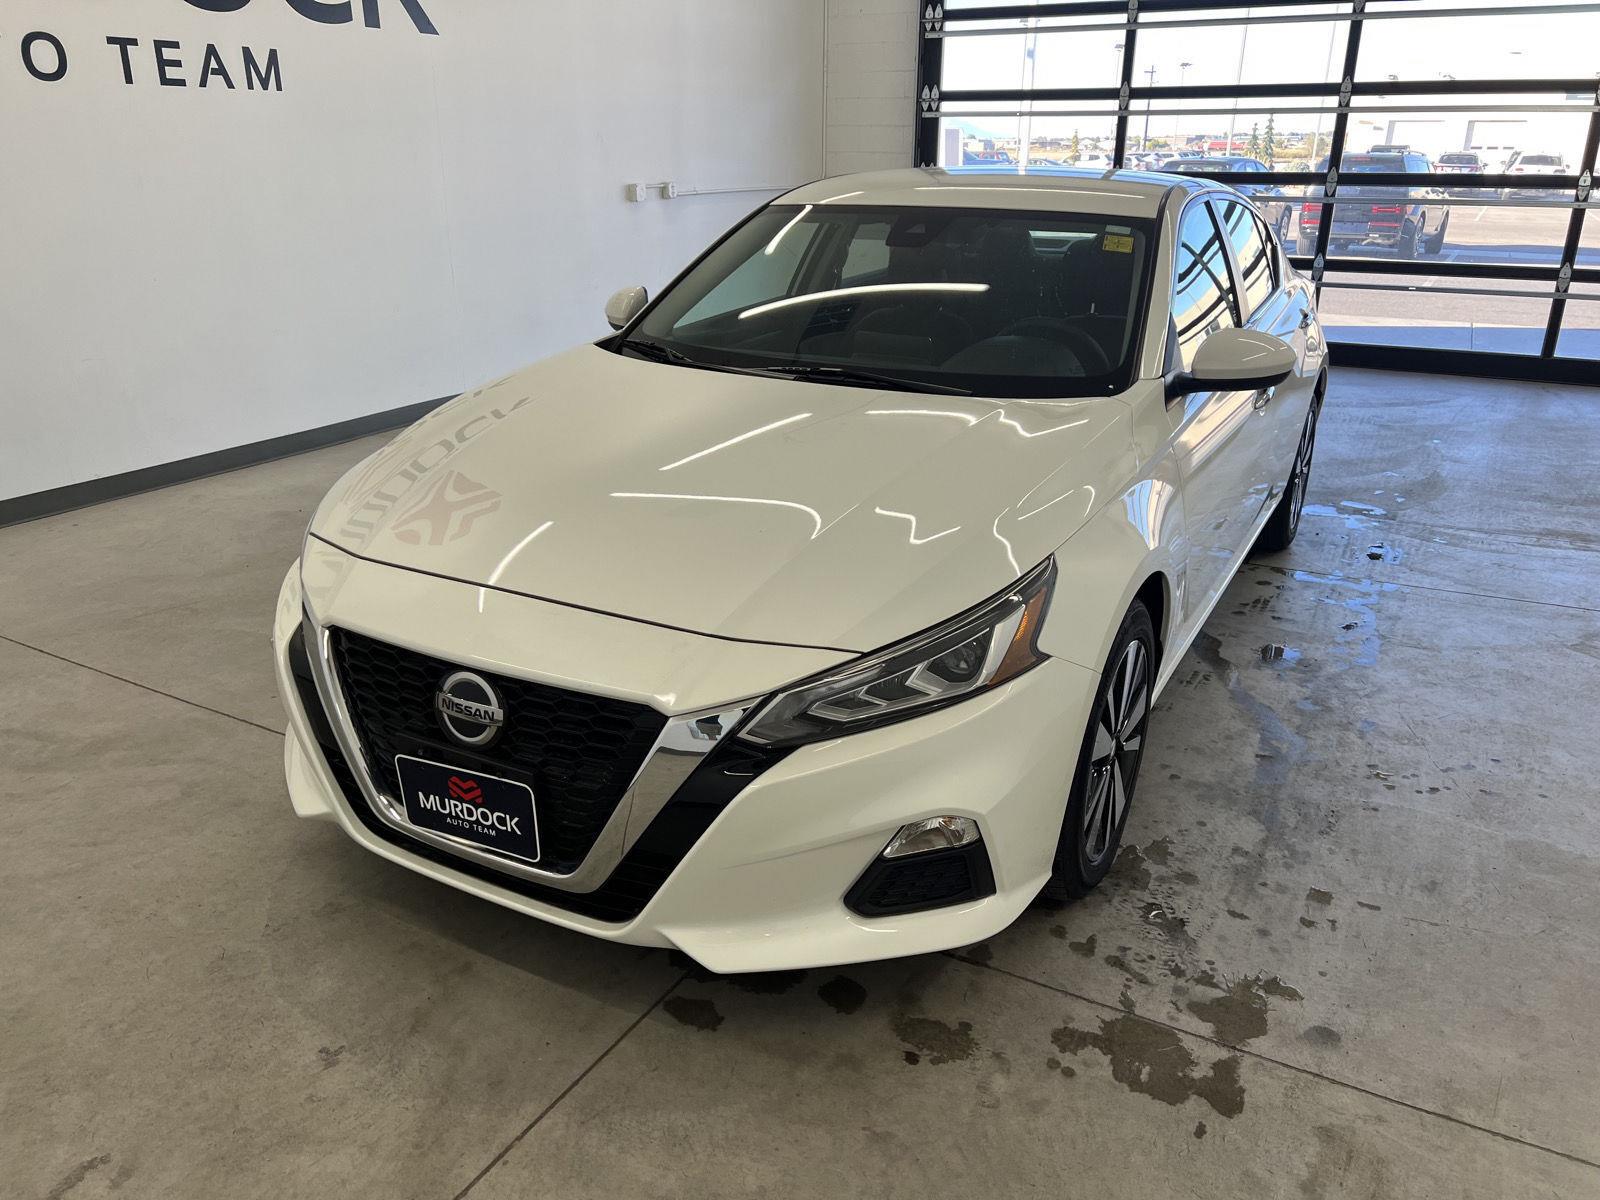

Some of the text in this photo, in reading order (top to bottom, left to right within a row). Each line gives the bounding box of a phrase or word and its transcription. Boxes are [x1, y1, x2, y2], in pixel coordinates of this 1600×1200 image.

[105, 35, 283, 92] TEAM
[441, 697, 495, 722] NISSAN
[418, 791, 522, 835] MURDOCK
[446, 817, 497, 837] AUTO TEAM
